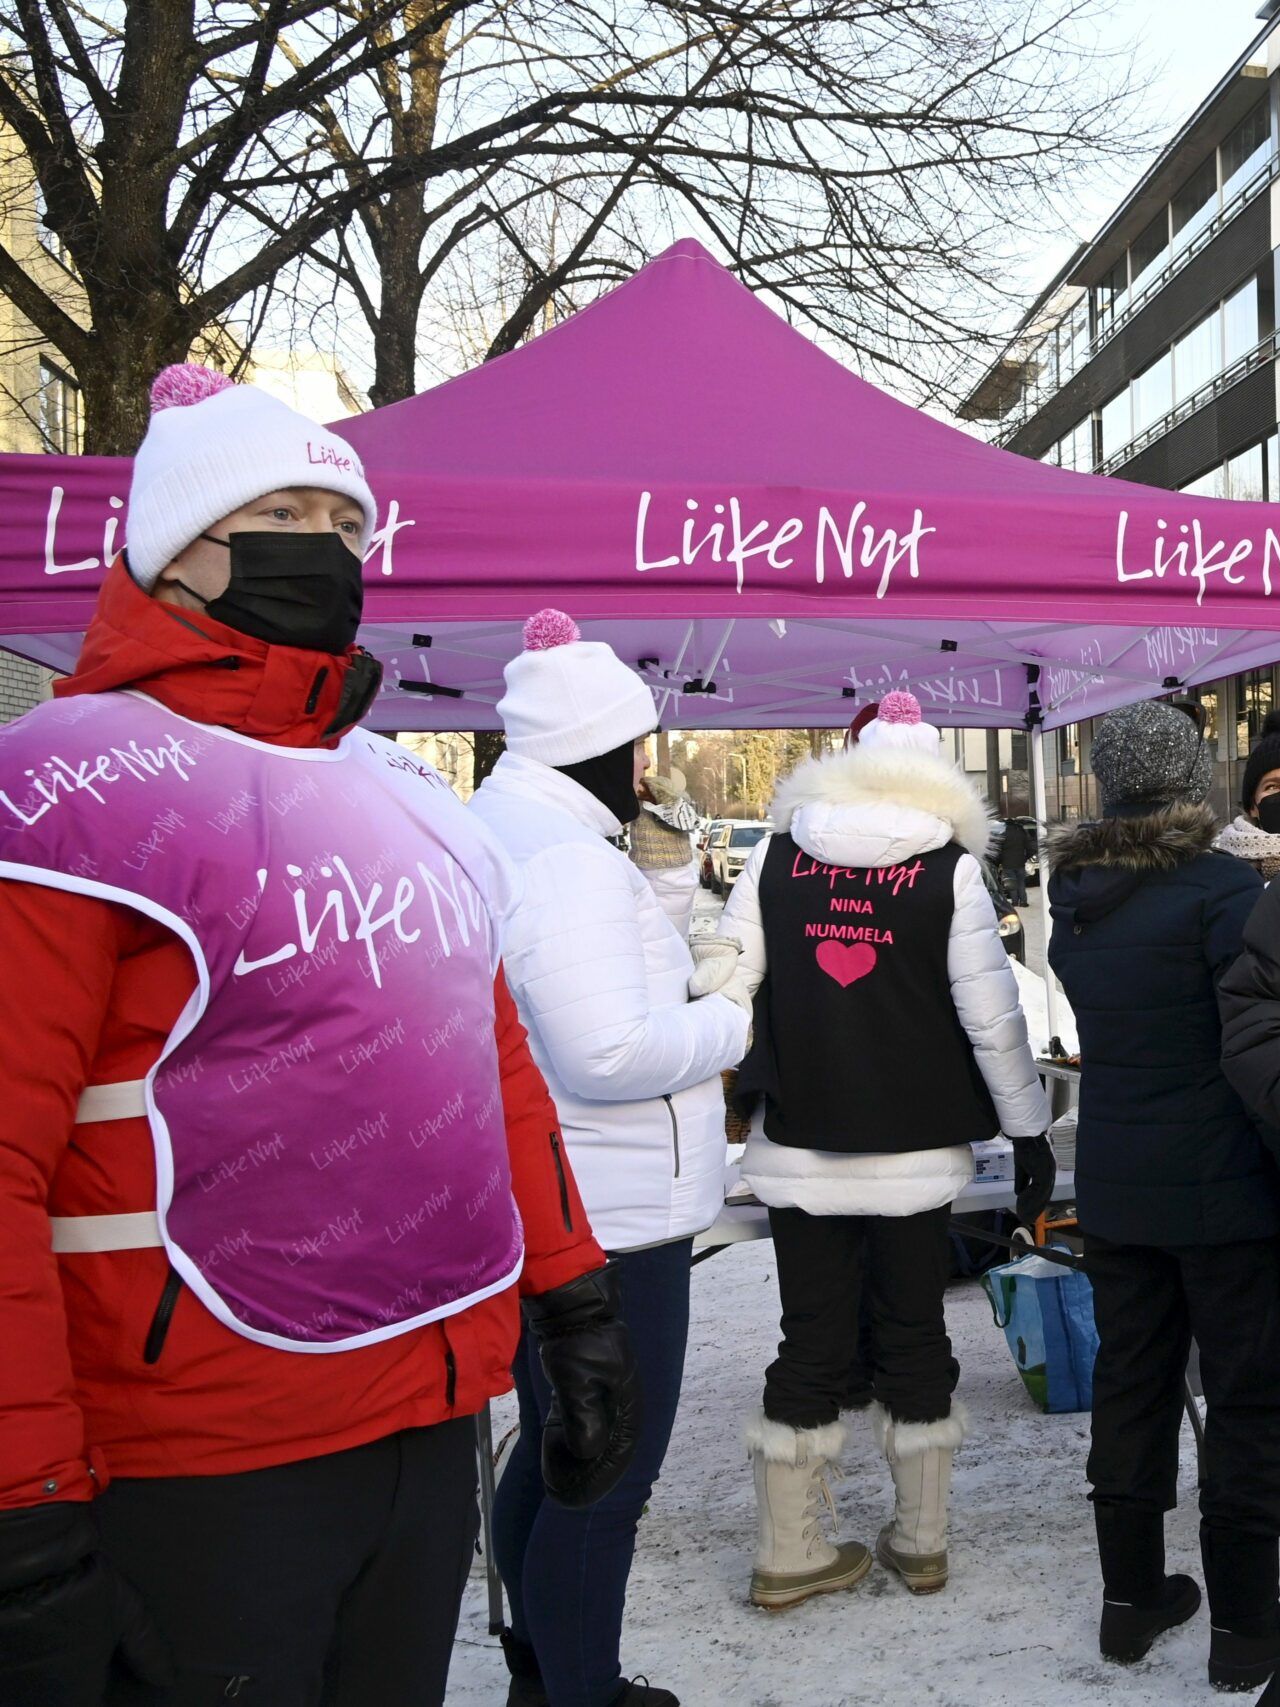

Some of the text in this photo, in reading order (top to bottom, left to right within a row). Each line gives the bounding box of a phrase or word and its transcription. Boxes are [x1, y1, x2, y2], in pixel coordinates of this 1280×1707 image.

[306, 442, 351, 475] Liike
[636, 491, 936, 599] Liike Nyt
[1116, 510, 1253, 607] Liike
[0, 755, 119, 826] Liike
[109, 733, 197, 782] Nyt
[233, 850, 494, 989] Liike Ny
[805, 923, 894, 945] NUMMELA
[830, 897, 874, 915] NINA
